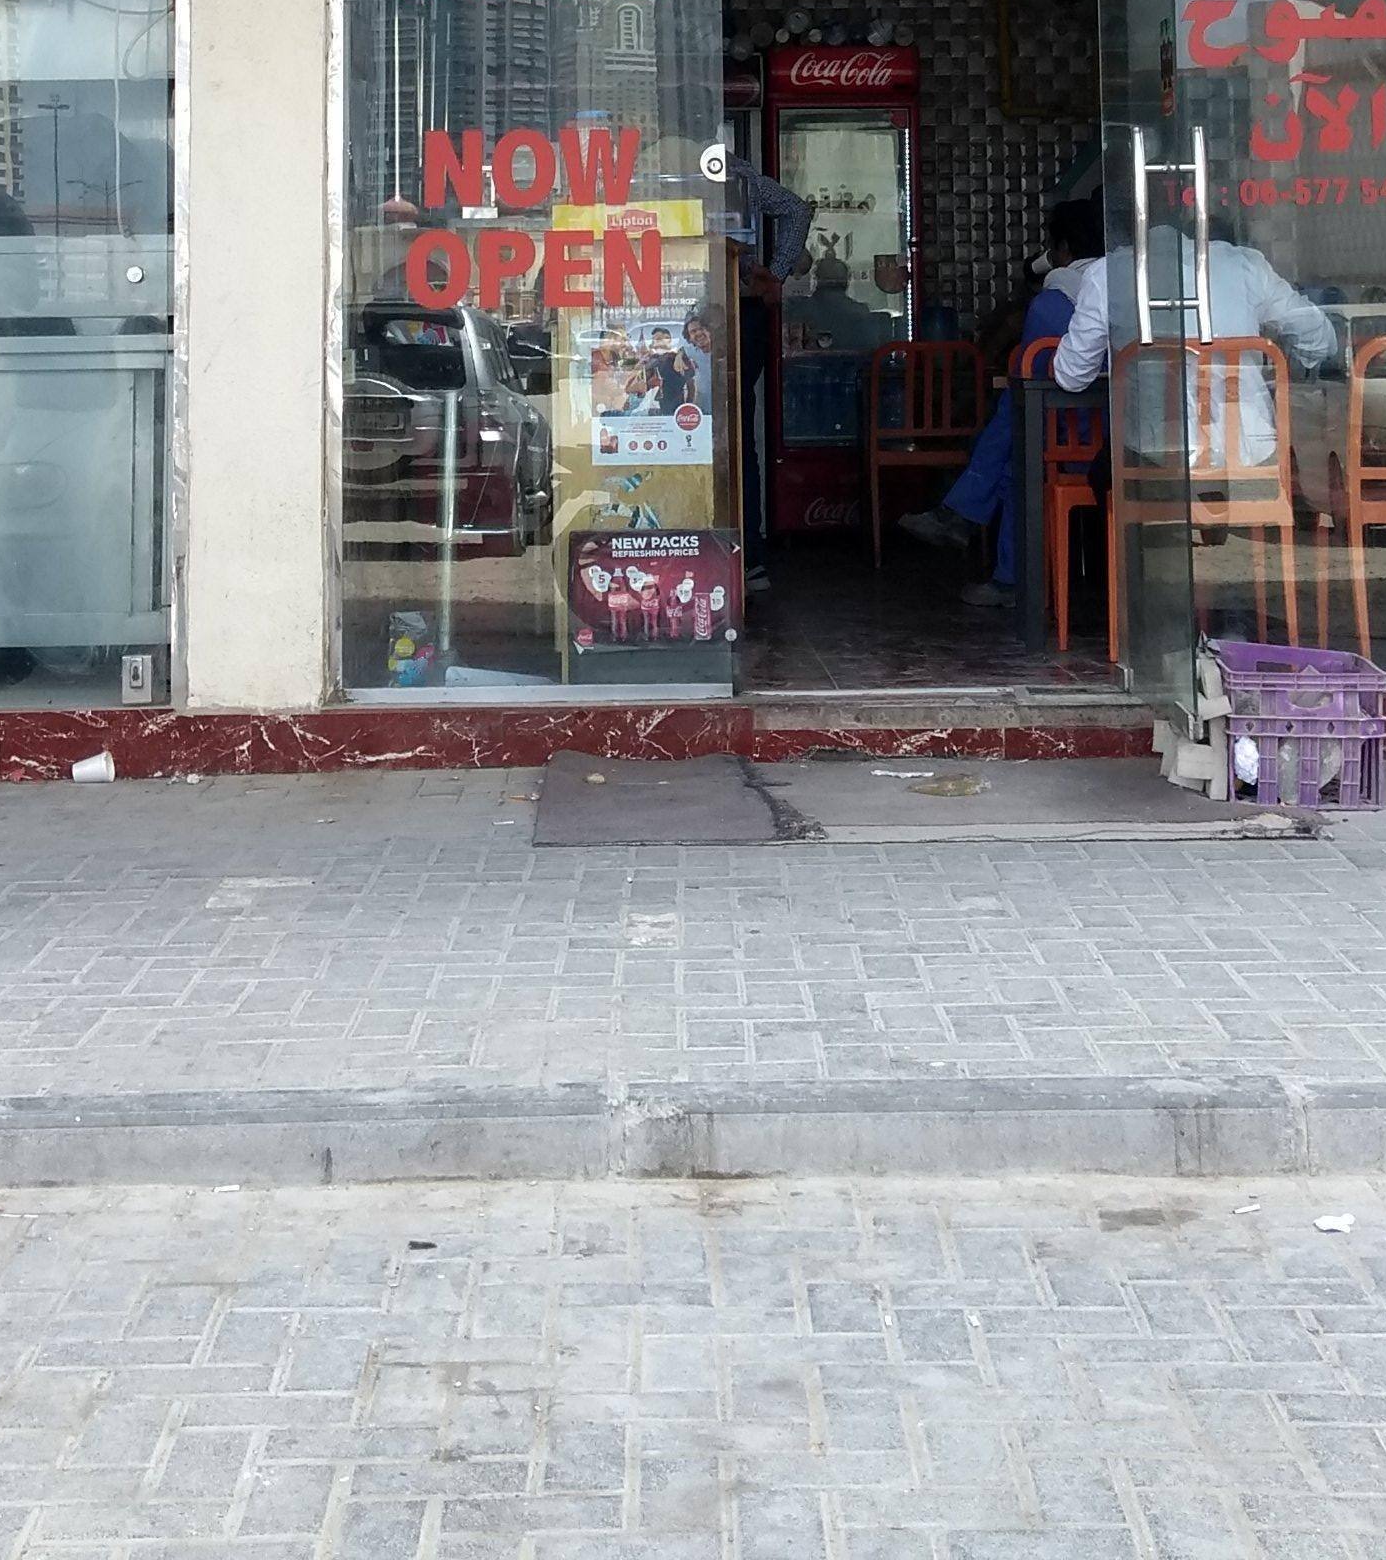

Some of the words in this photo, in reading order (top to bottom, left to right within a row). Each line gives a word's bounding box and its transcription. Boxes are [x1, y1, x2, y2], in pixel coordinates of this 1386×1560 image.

[423, 127, 641, 209] NOW
[1238, 176, 1350, 207] 06-577
[611, 215, 654, 229] Lipton
[405, 228, 663, 310] OPEN
[611, 537, 647, 550] NEW
[651, 535, 700, 549] PACKS
[611, 548, 667, 558] REFRESHING
[668, 547, 700, 557] PRICES
